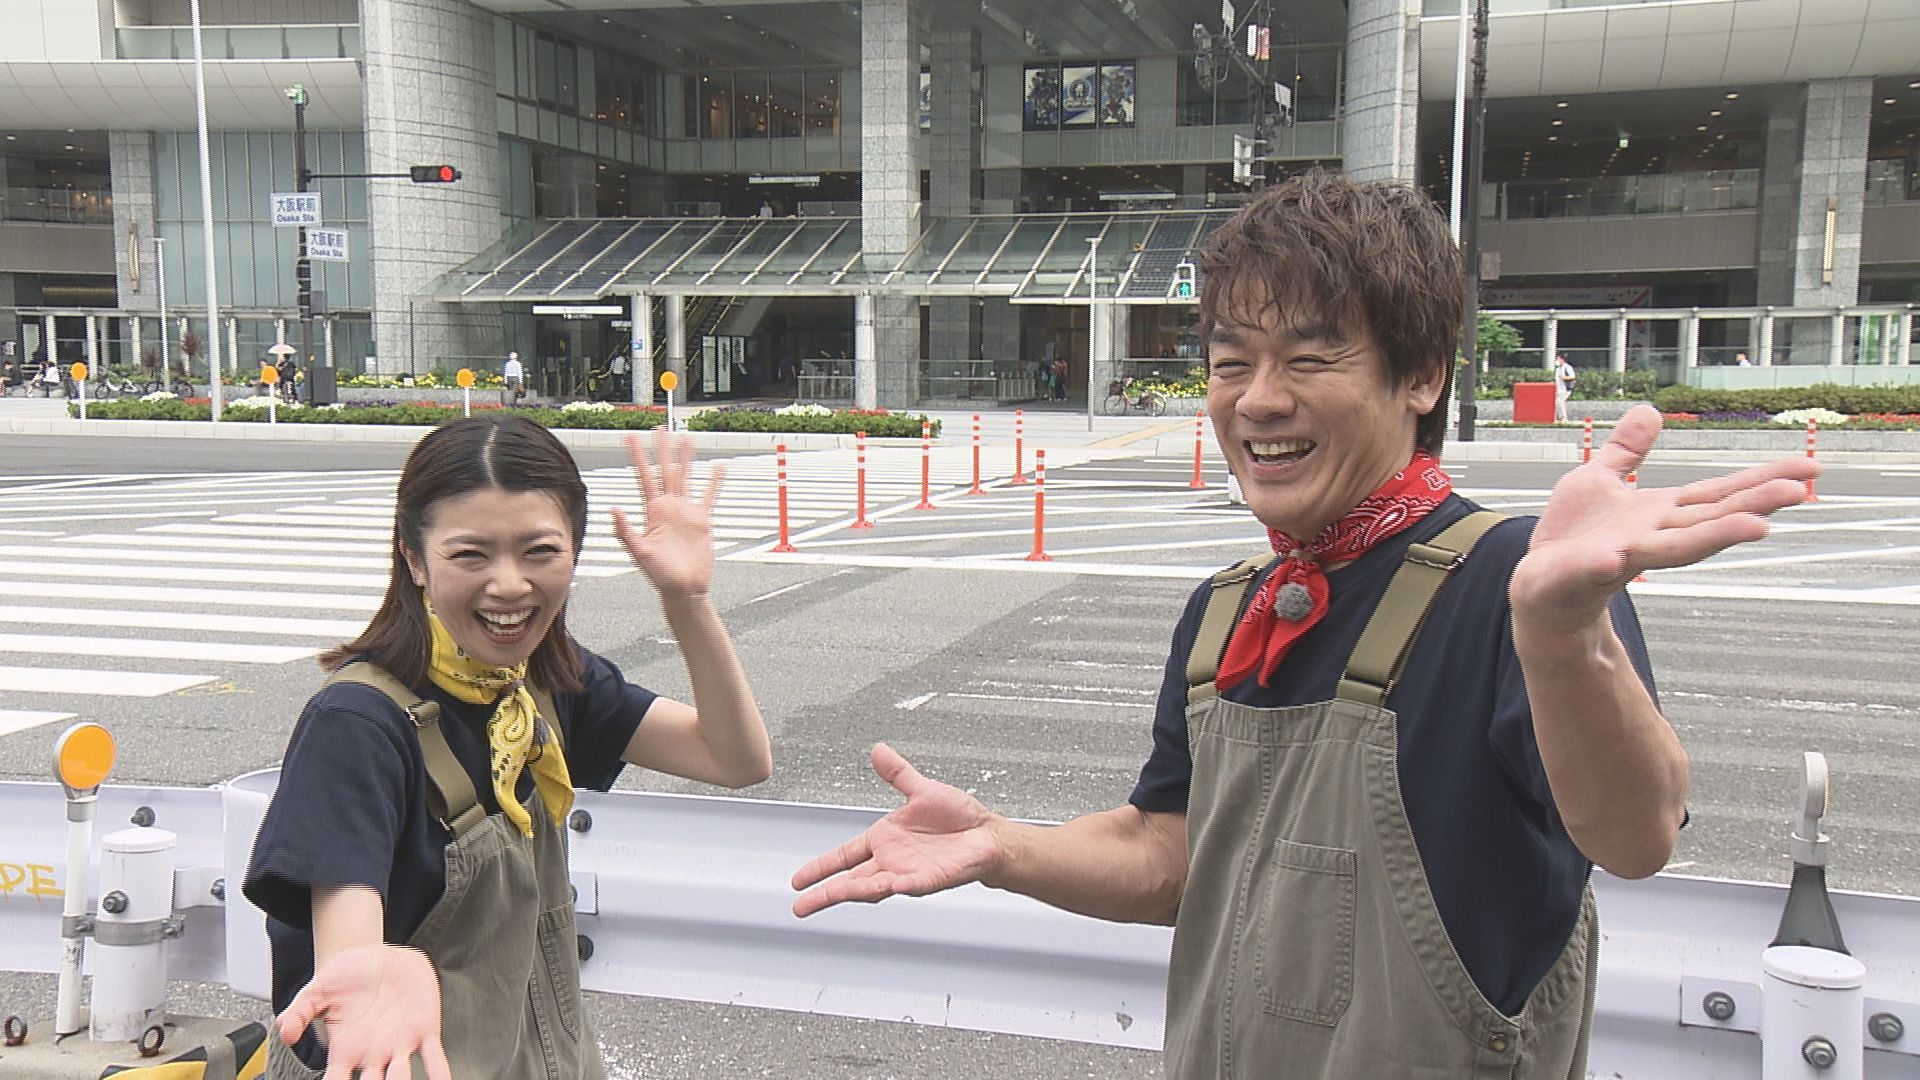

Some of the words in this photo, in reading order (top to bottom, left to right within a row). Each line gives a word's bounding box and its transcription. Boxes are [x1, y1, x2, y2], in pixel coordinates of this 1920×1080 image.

[276, 198, 315, 212] 大阪駅前
[276, 214, 300, 222] Osaka
[310, 232, 344, 247] 大阪駅前
[310, 248, 330, 257] Osaka
